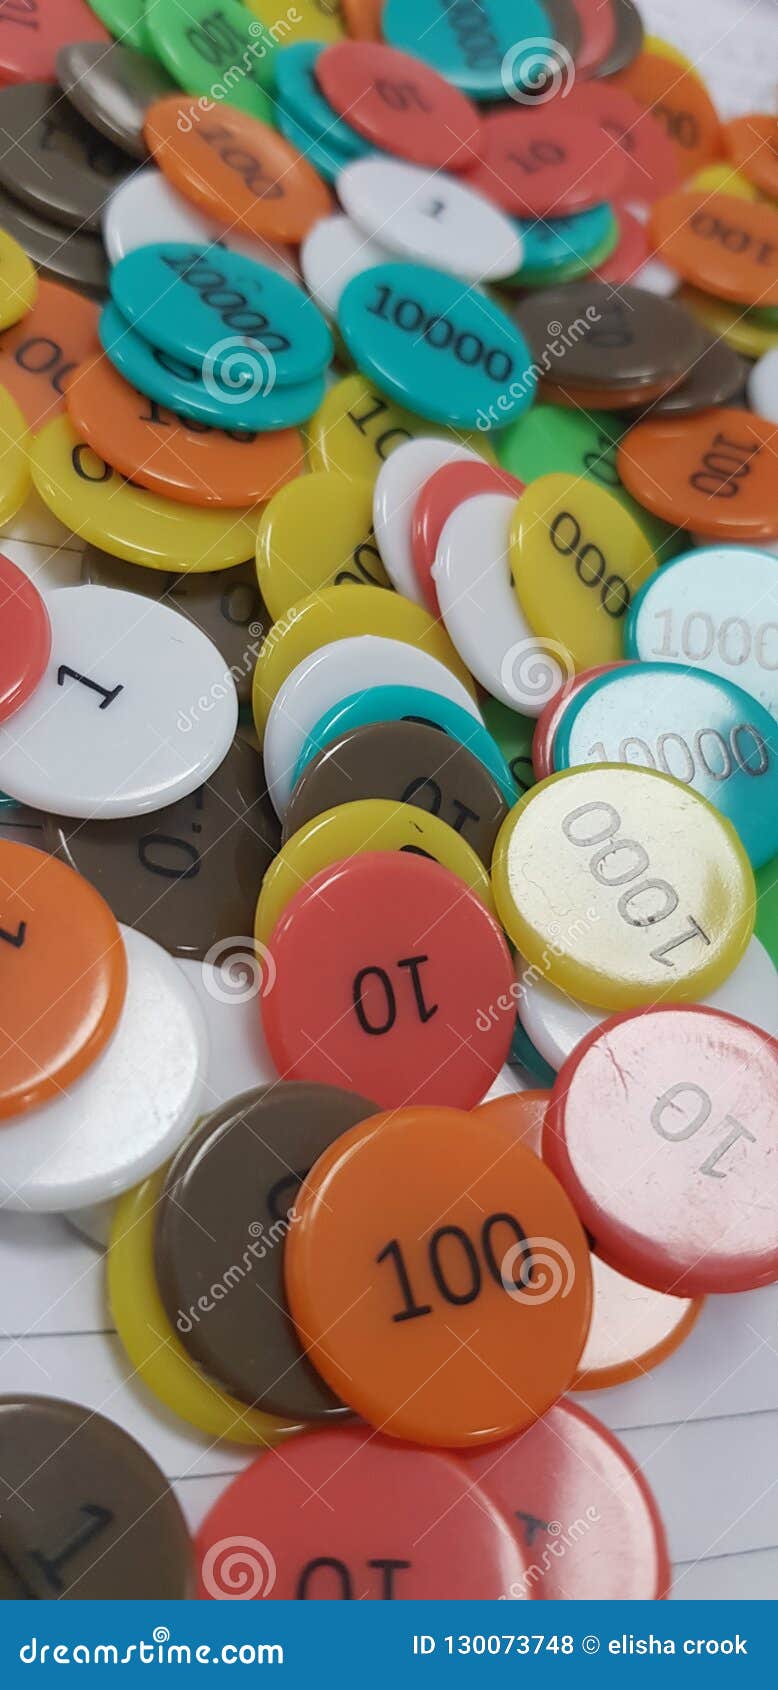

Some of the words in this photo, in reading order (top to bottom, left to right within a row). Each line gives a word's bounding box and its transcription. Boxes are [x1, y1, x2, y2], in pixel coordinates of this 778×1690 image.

[160, 251, 292, 353] 10000
[366, 281, 514, 384] 10000
[688, 433, 761, 499] 100
[57, 664, 125, 710] 1
[560, 800, 711, 968] 1000
[352, 954, 439, 1037] 10
[649, 1081, 757, 1180] 10
[376, 1211, 537, 1324] 100
